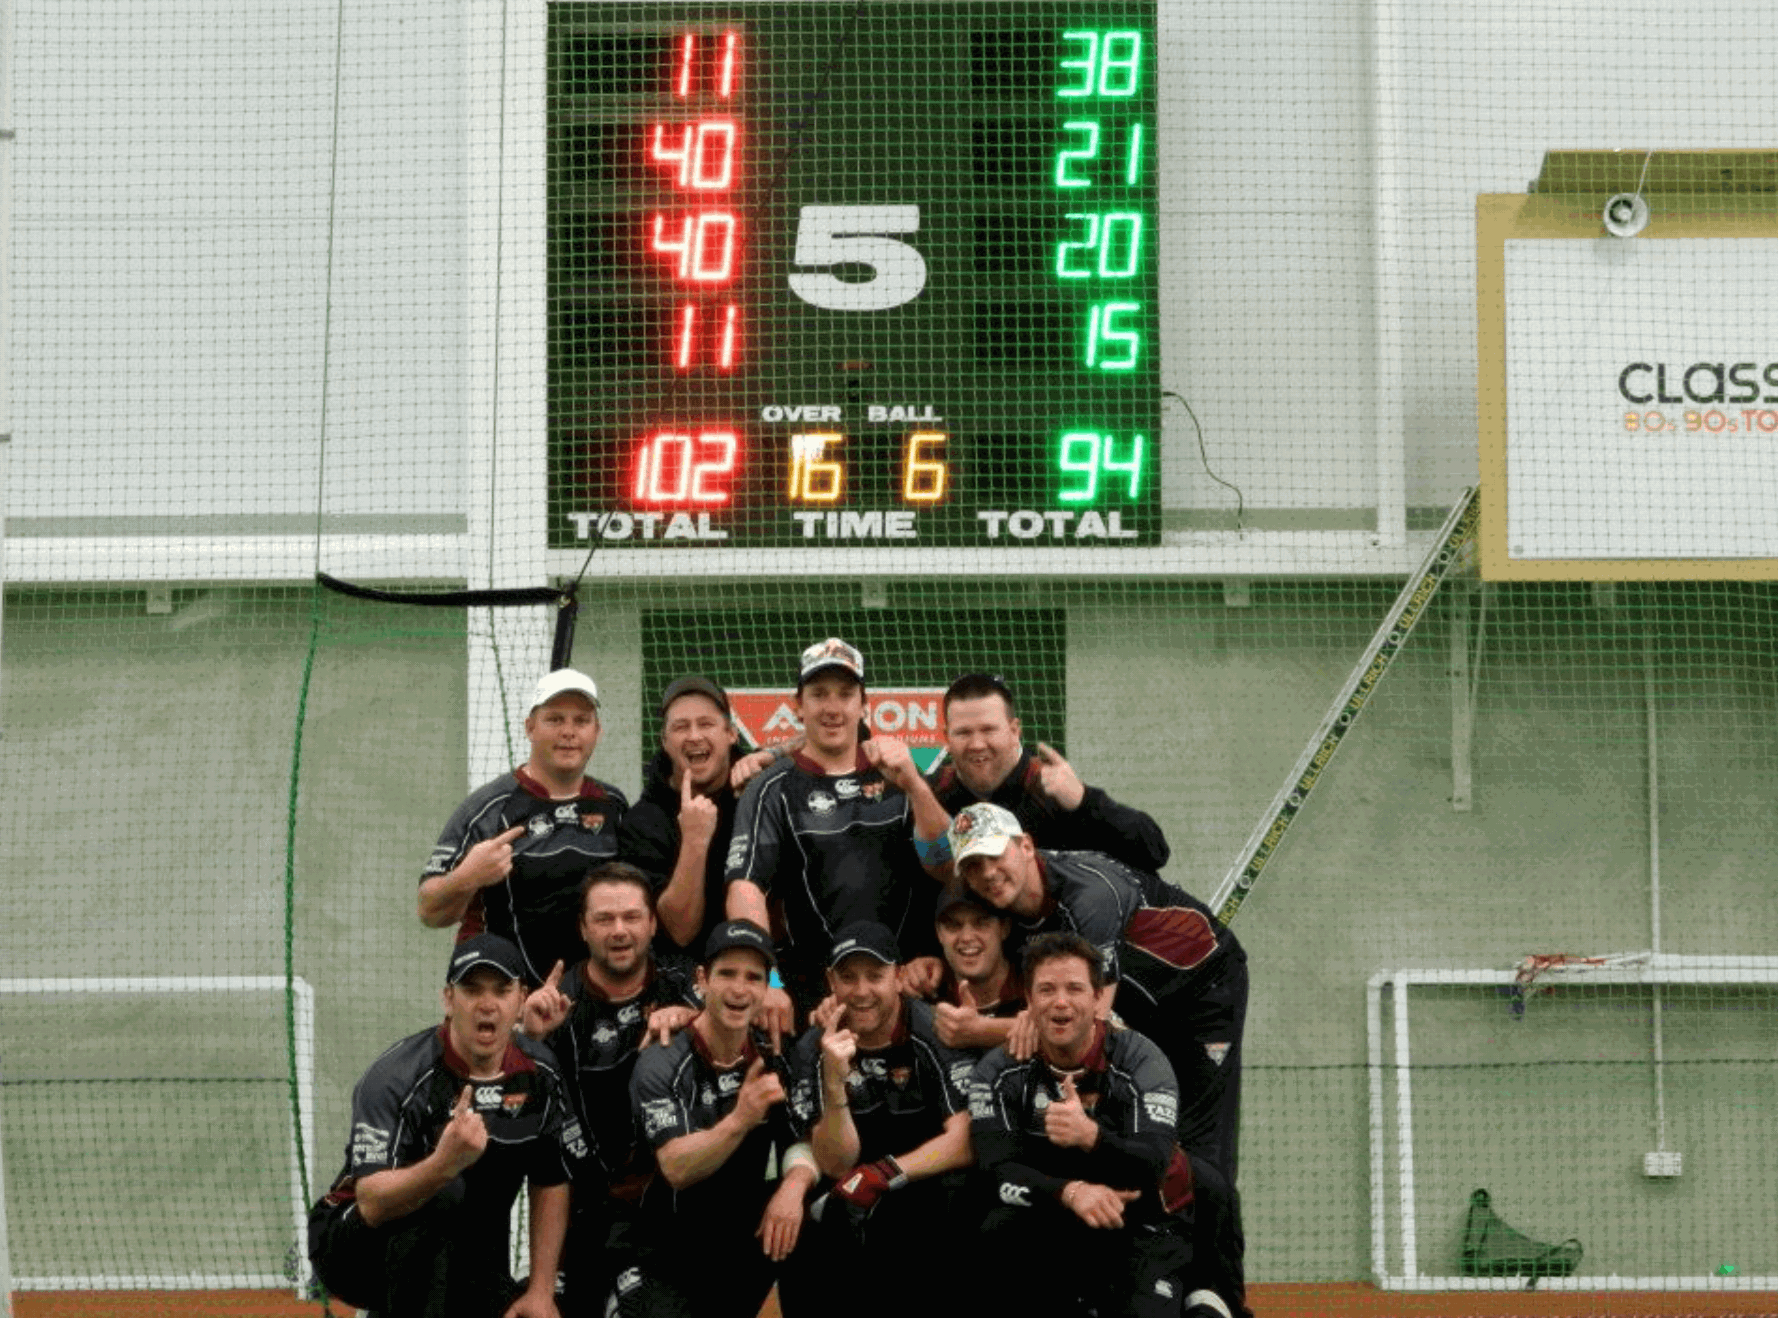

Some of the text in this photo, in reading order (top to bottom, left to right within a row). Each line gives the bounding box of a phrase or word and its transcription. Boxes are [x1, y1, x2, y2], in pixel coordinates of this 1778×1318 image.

[676, 31, 737, 97] 11
[1055, 29, 1143, 97] 38
[649, 120, 736, 190] 40
[1055, 120, 1143, 188] 21
[649, 211, 736, 282] 40
[787, 204, 928, 311] 5
[1055, 211, 1143, 279] 20
[676, 303, 737, 370] 11
[1085, 301, 1142, 370] 15
[761, 405, 942, 423] OVER BALL
[632, 431, 737, 502] 102
[903, 432, 947, 502] 6
[1057, 431, 1145, 502] 94
[567, 511, 729, 540] TOTAL
[793, 511, 917, 540] TIME
[977, 510, 1139, 540] TOTAL
